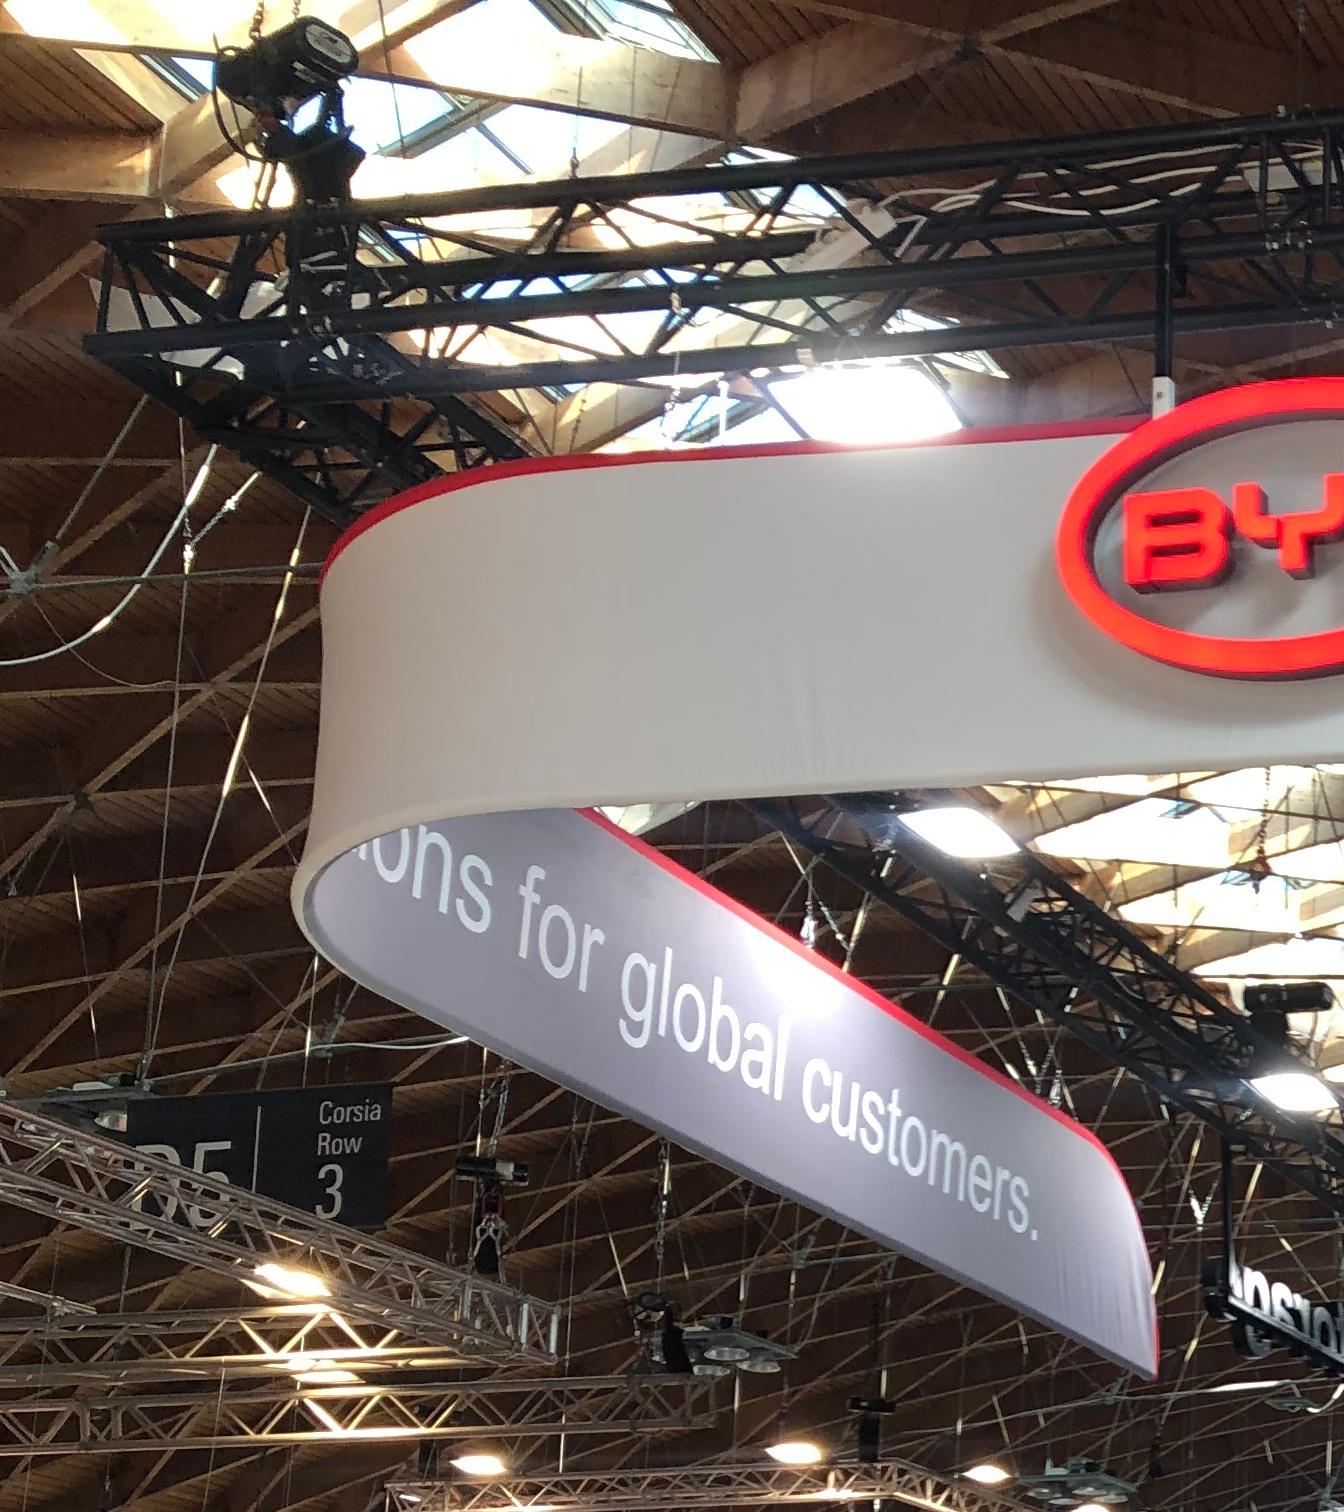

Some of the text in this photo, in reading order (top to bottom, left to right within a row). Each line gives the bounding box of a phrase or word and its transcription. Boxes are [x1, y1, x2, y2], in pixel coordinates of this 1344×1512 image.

[518, 865, 605, 991] for
[618, 946, 791, 1100] global
[801, 1055, 1039, 1241] customers.
[319, 1099, 382, 1125] Corsia
[317, 1132, 363, 1156] Row
[315, 1163, 344, 1219] 3
